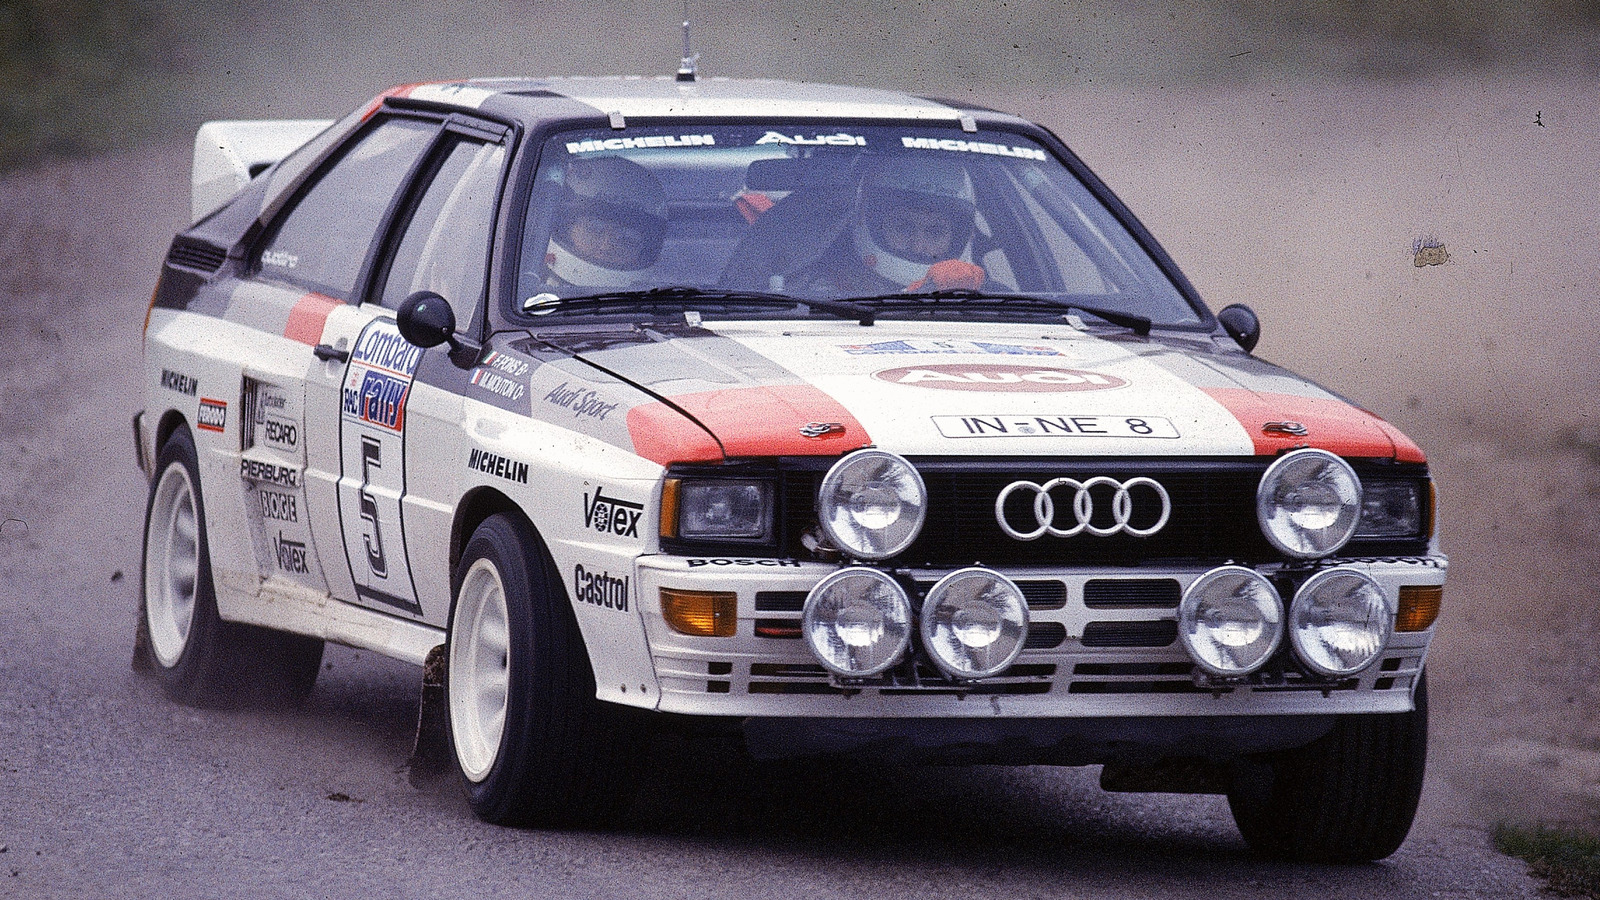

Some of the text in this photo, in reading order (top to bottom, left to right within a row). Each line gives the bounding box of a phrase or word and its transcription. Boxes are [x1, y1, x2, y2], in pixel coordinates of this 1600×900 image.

[566, 134, 715, 155] MICHELIN
[902, 137, 1047, 161] MICHELIN
[353, 328, 425, 375] Lombard
[160, 368, 199, 397] MICHELIN
[359, 376, 408, 427] rally
[543, 381, 619, 421] Audi Sport
[265, 420, 297, 446] RECARO
[1125, 418, 1153, 435] 8
[240, 459, 297, 486] PIERBURG
[468, 448, 529, 485] MICHELIN
[259, 491, 298, 523] BOGE
[360, 434, 388, 579] 5
[686, 558, 801, 568] BOSCH
[574, 563, 629, 612] Castrol
